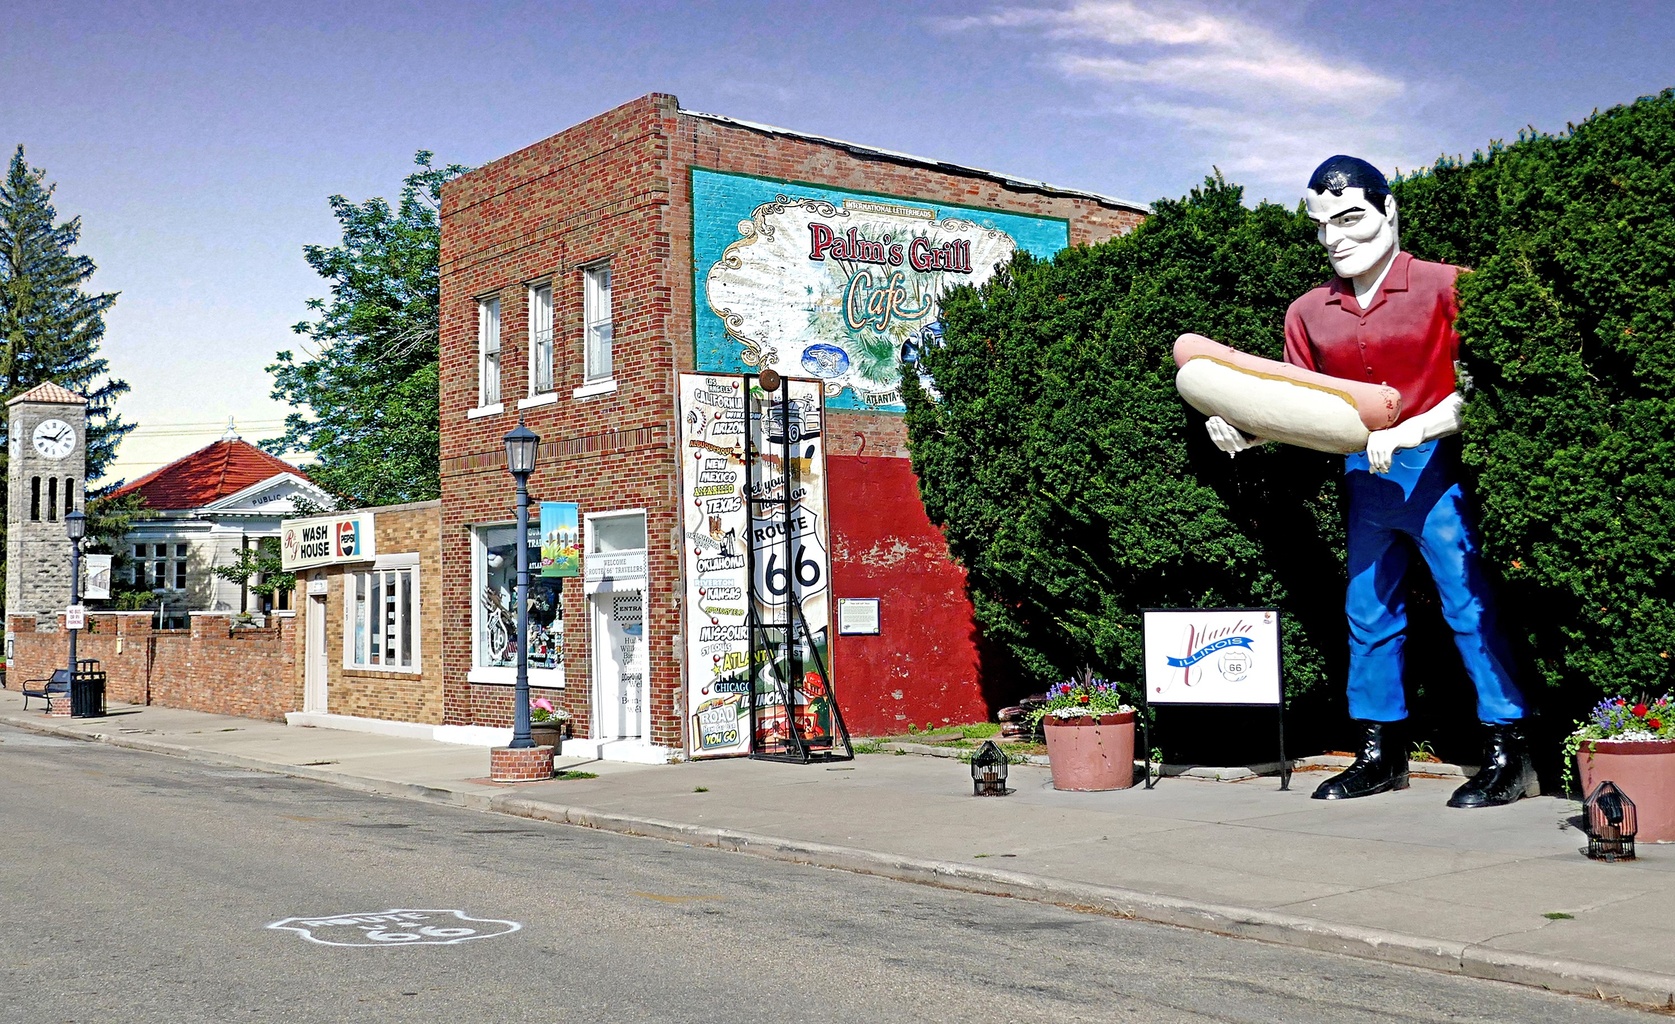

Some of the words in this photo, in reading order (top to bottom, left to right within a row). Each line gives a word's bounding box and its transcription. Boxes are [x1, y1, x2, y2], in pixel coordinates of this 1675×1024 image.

[846, 201, 892, 213] INTERNATIONAL
[893, 207, 932, 217] LETTERHEADS
[808, 222, 903, 266] Palm's
[908, 237, 973, 273] Grill
[842, 269, 932, 333] Cafe
[706, 378, 717, 386] LOS
[694, 388, 743, 409] CALIFORNIA
[866, 392, 897, 404] ATLANTA
[726, 411, 762, 420] WINSOW
[712, 421, 745, 435] ARIZON
[705, 458, 728, 470] NEW
[699, 471, 737, 483] MEXICO
[693, 484, 734, 497] AMARILLO
[792, 487, 807, 499] on
[252, 494, 281, 506] PUBLIC
[706, 497, 742, 514] TEXAS
[302, 525, 328, 542] WASH
[754, 516, 808, 542] ROUTE
[341, 533, 355, 544] PEPSI
[301, 542, 330, 559] HOUSE
[615, 566, 643, 574] TRAVELERS
[697, 555, 745, 573] OKLAHOMA
[765, 544, 820, 596] 66
[707, 587, 742, 600] KANSAS
[711, 643, 732, 653] LOUIS
[1179, 637, 1243, 667] ILLINOIS
[1229, 664, 1242, 672] 66
[740, 691, 787, 709] ILINOIS
[701, 706, 735, 724] ROAD
[705, 732, 724, 745] YOU
[723, 730, 737, 742] GO
[366, 926, 476, 941] 66
